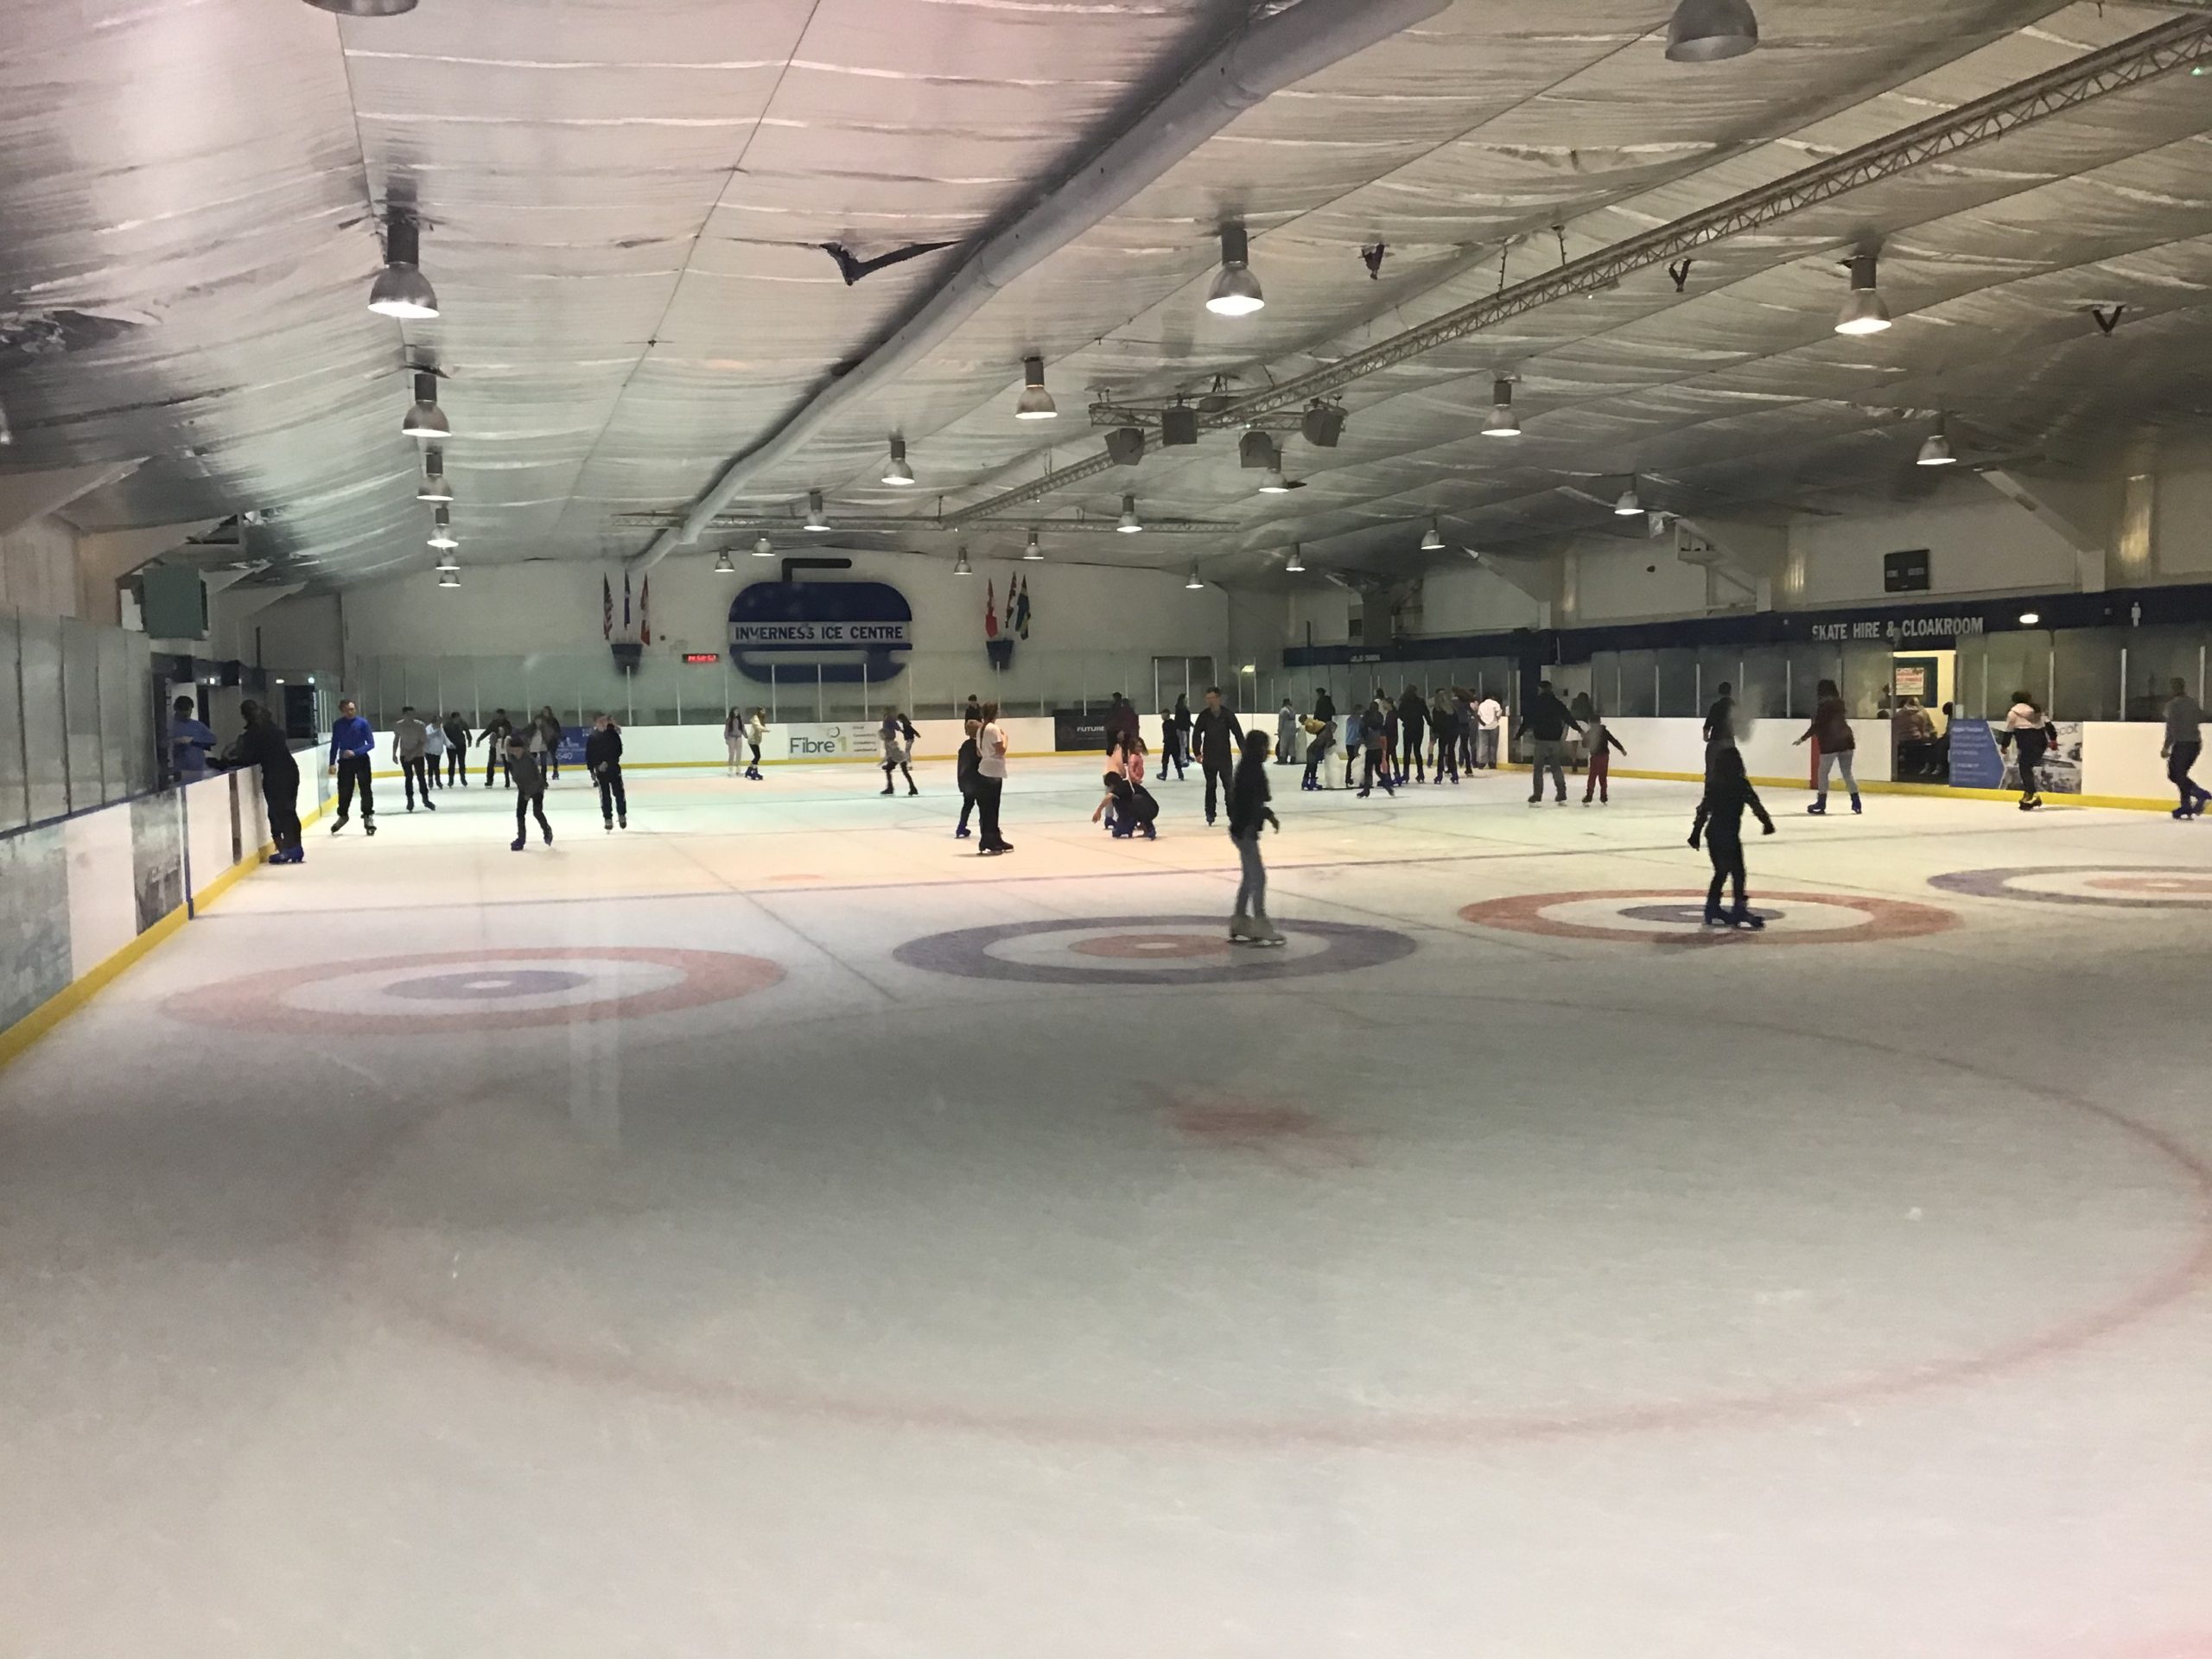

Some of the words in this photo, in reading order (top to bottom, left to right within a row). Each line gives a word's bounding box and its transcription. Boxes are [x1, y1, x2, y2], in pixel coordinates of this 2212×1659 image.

[735, 626, 815, 640] INVERNESS
[822, 626, 843, 639] ICE
[850, 626, 903, 639] CENTRE
[1812, 624, 1847, 641] SKATE
[1853, 621, 1880, 639] HIRE
[1886, 620, 1894, 638] &
[1902, 617, 1984, 637] CLOAKROOM
